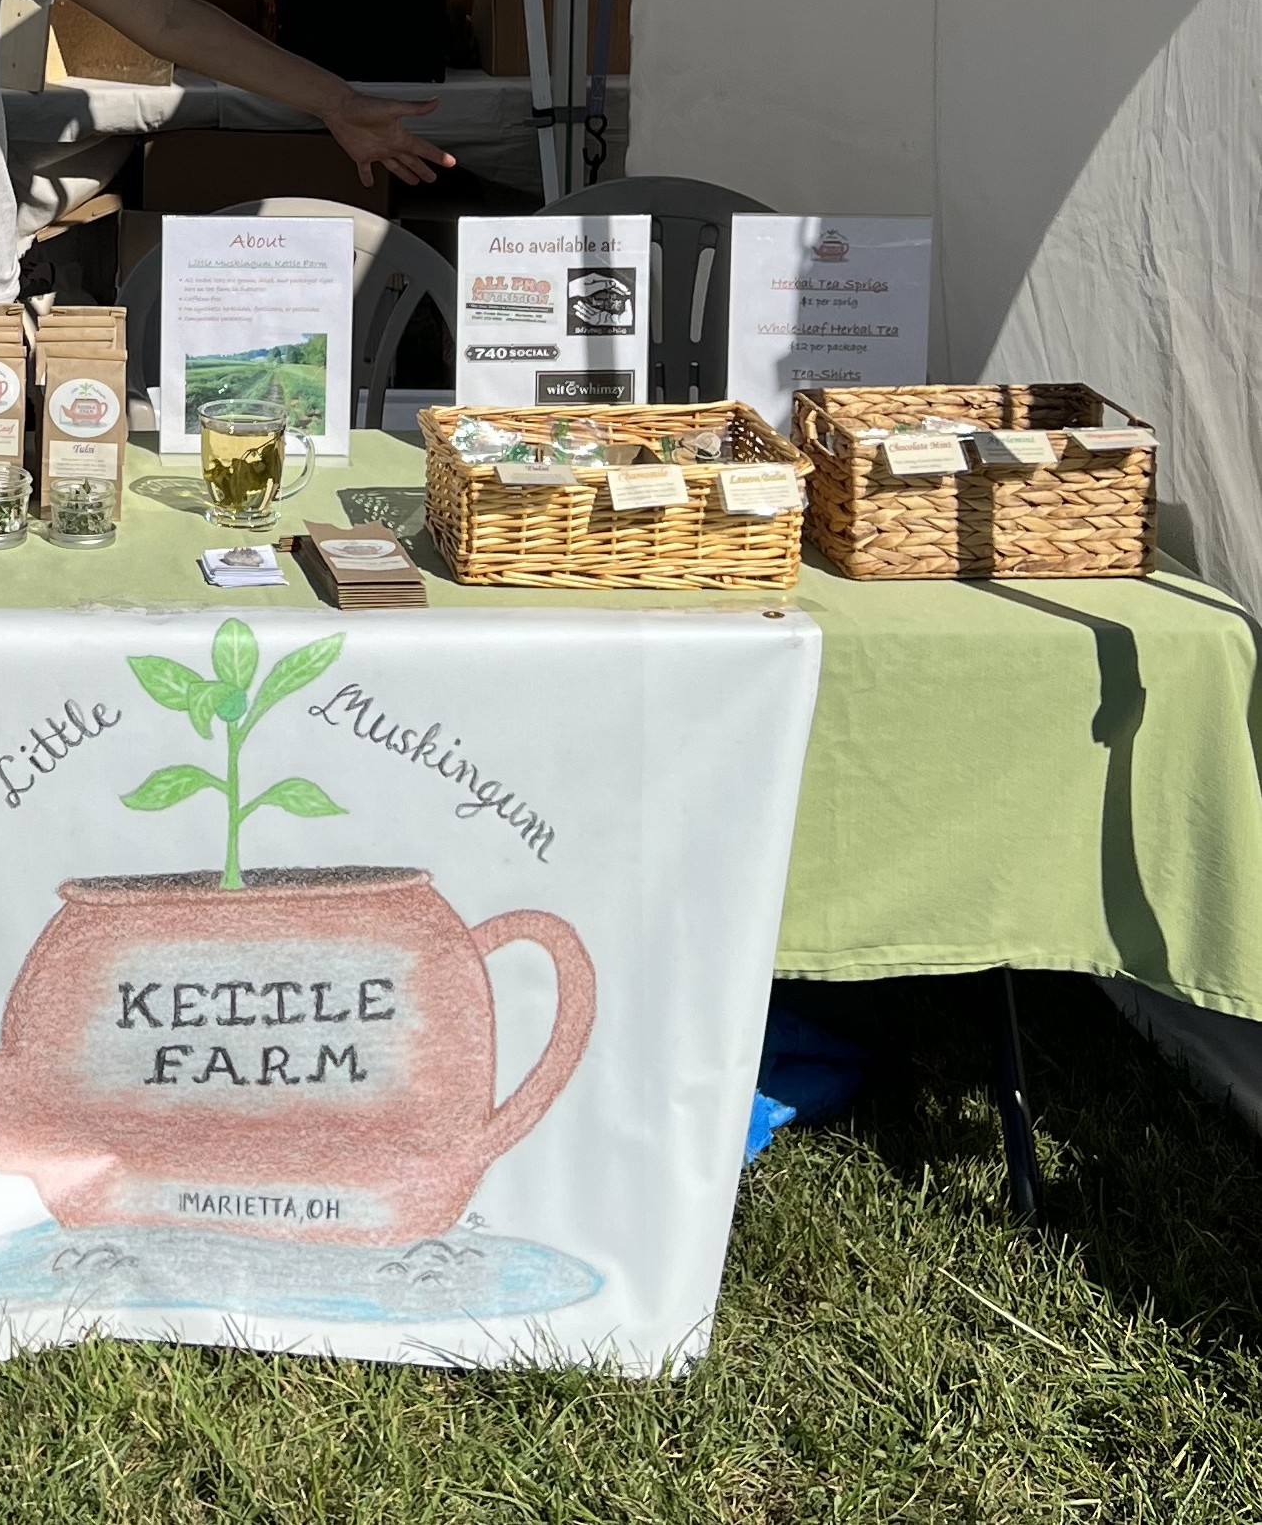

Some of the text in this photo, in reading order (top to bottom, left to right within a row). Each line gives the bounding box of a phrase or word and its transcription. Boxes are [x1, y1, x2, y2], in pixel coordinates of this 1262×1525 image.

[229, 231, 286, 250] About
[488, 235, 622, 254] Also available at:
[188, 259, 212, 268] Little
[275, 259, 301, 269] Kettle
[302, 259, 328, 269] Farm
[472, 276, 552, 295] ALL PRO
[771, 277, 889, 294] Herbal Tea Sprigs
[471, 291, 550, 305] NUTRITION
[799, 297, 859, 308] $1 per sprig
[757, 322, 899, 337] Whole-leaf Herbal Tea
[474, 347, 550, 360] 740 SOCIAL
[790, 341, 868, 354] $12 per package
[791, 368, 862, 381] Tea-Shirts
[546, 384, 565, 395] wit
[71, 443, 95, 454] Tulsi
[888, 441, 952, 453] Chocolate Mint
[729, 474, 761, 485] Lemon
[308, 681, 556, 864] Muskingum
[116, 977, 398, 1032] KETTLE
[143, 1044, 370, 1087] FARM
